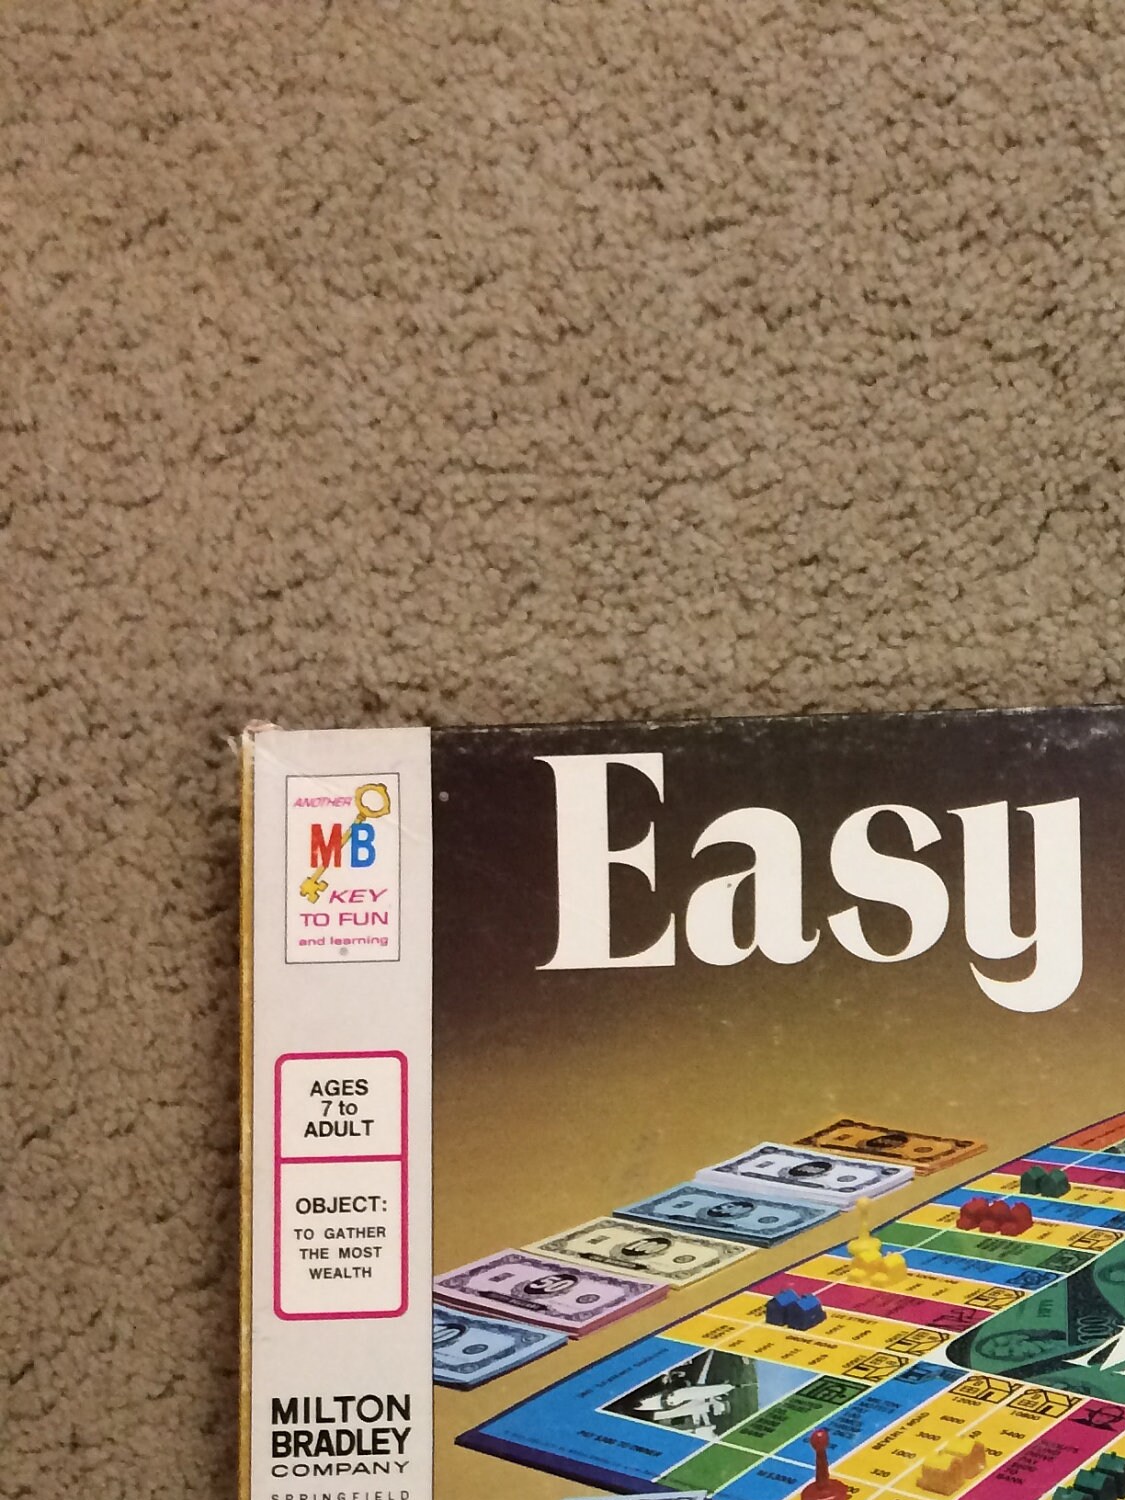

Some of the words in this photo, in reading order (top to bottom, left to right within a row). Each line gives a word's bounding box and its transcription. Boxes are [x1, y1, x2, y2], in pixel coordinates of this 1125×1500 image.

[293, 797, 352, 808] ANOTHER
[534, 752, 1083, 1012] Easy
[329, 888, 388, 904] KEY
[300, 913, 330, 927] TO
[339, 911, 388, 926] FUN
[299, 936, 325, 946] and
[330, 936, 388, 947] learning
[310, 1078, 369, 1098] AGES
[322, 1100, 332, 1116] 7
[338, 1099, 359, 1117] to
[304, 1119, 374, 1139] ADULT
[296, 1195, 388, 1215] OBJECT:
[295, 1229, 315, 1241] TO
[324, 1225, 387, 1240] GATHER
[300, 1247, 331, 1260] THE
[338, 1246, 382, 1259] MOST
[309, 1265, 373, 1280] WEALTH
[271, 1394, 411, 1425] MILTON
[271, 1427, 412, 1458] BRADLEY
[271, 1461, 409, 1478] COMPANY
